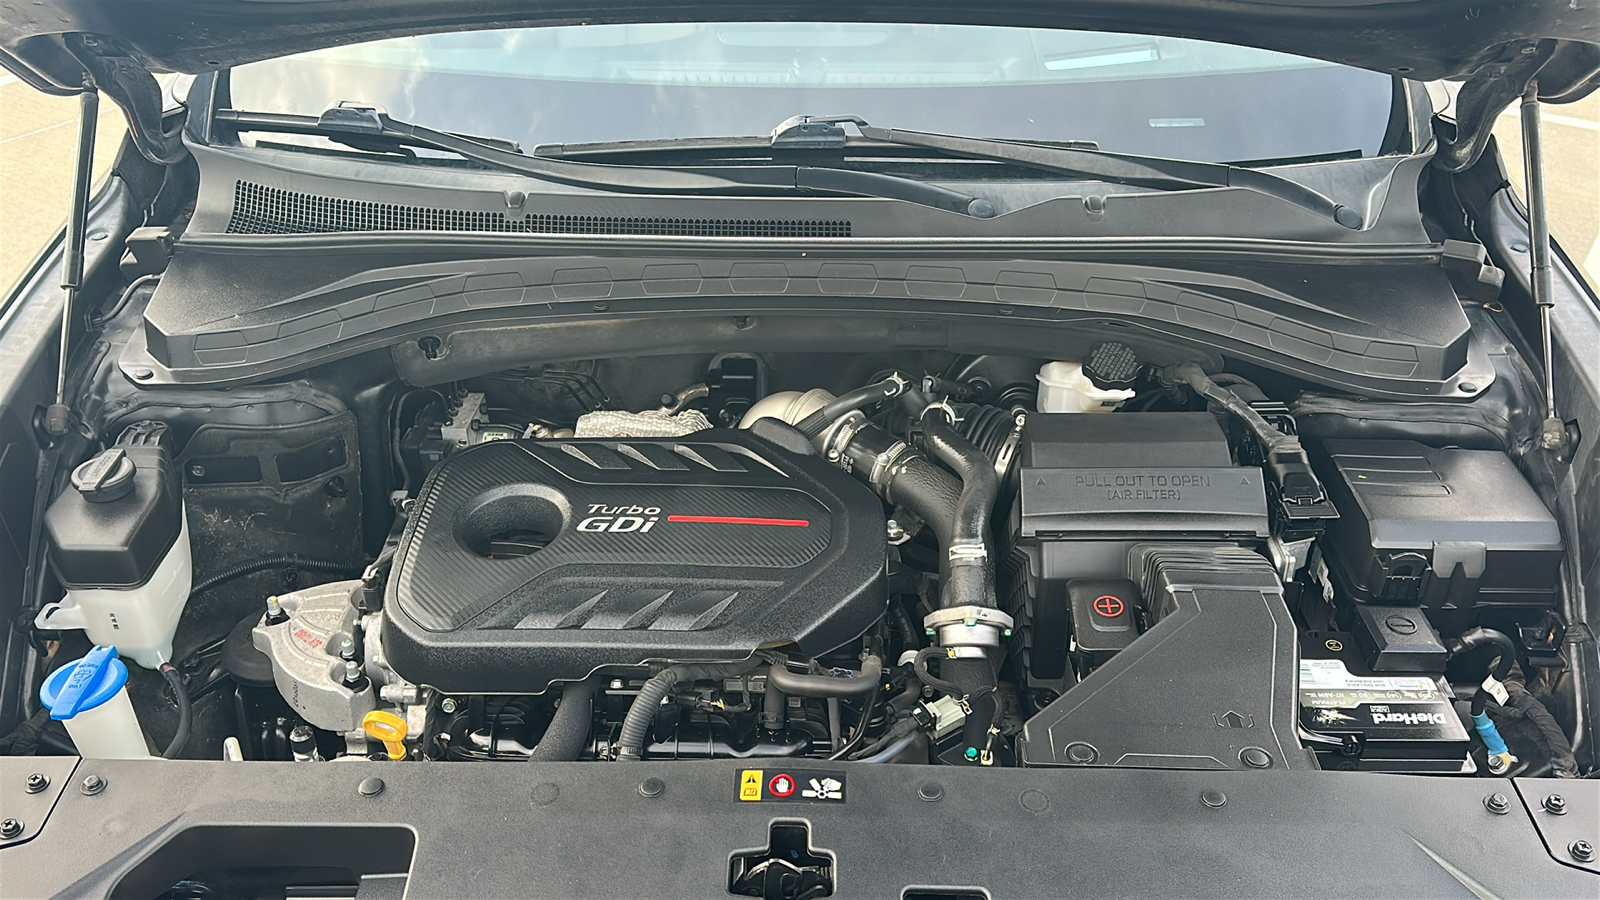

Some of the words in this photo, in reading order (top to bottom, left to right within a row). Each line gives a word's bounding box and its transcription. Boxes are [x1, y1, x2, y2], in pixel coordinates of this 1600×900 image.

[1075, 475, 1112, 487] PULL
[1115, 475, 1144, 487] OUT
[1148, 475, 1168, 487] TO
[1171, 475, 1211, 487] OPEN
[587, 503, 661, 515] Turbo
[576, 516, 659, 533] GDi
[1371, 713, 1448, 725] DieHard
